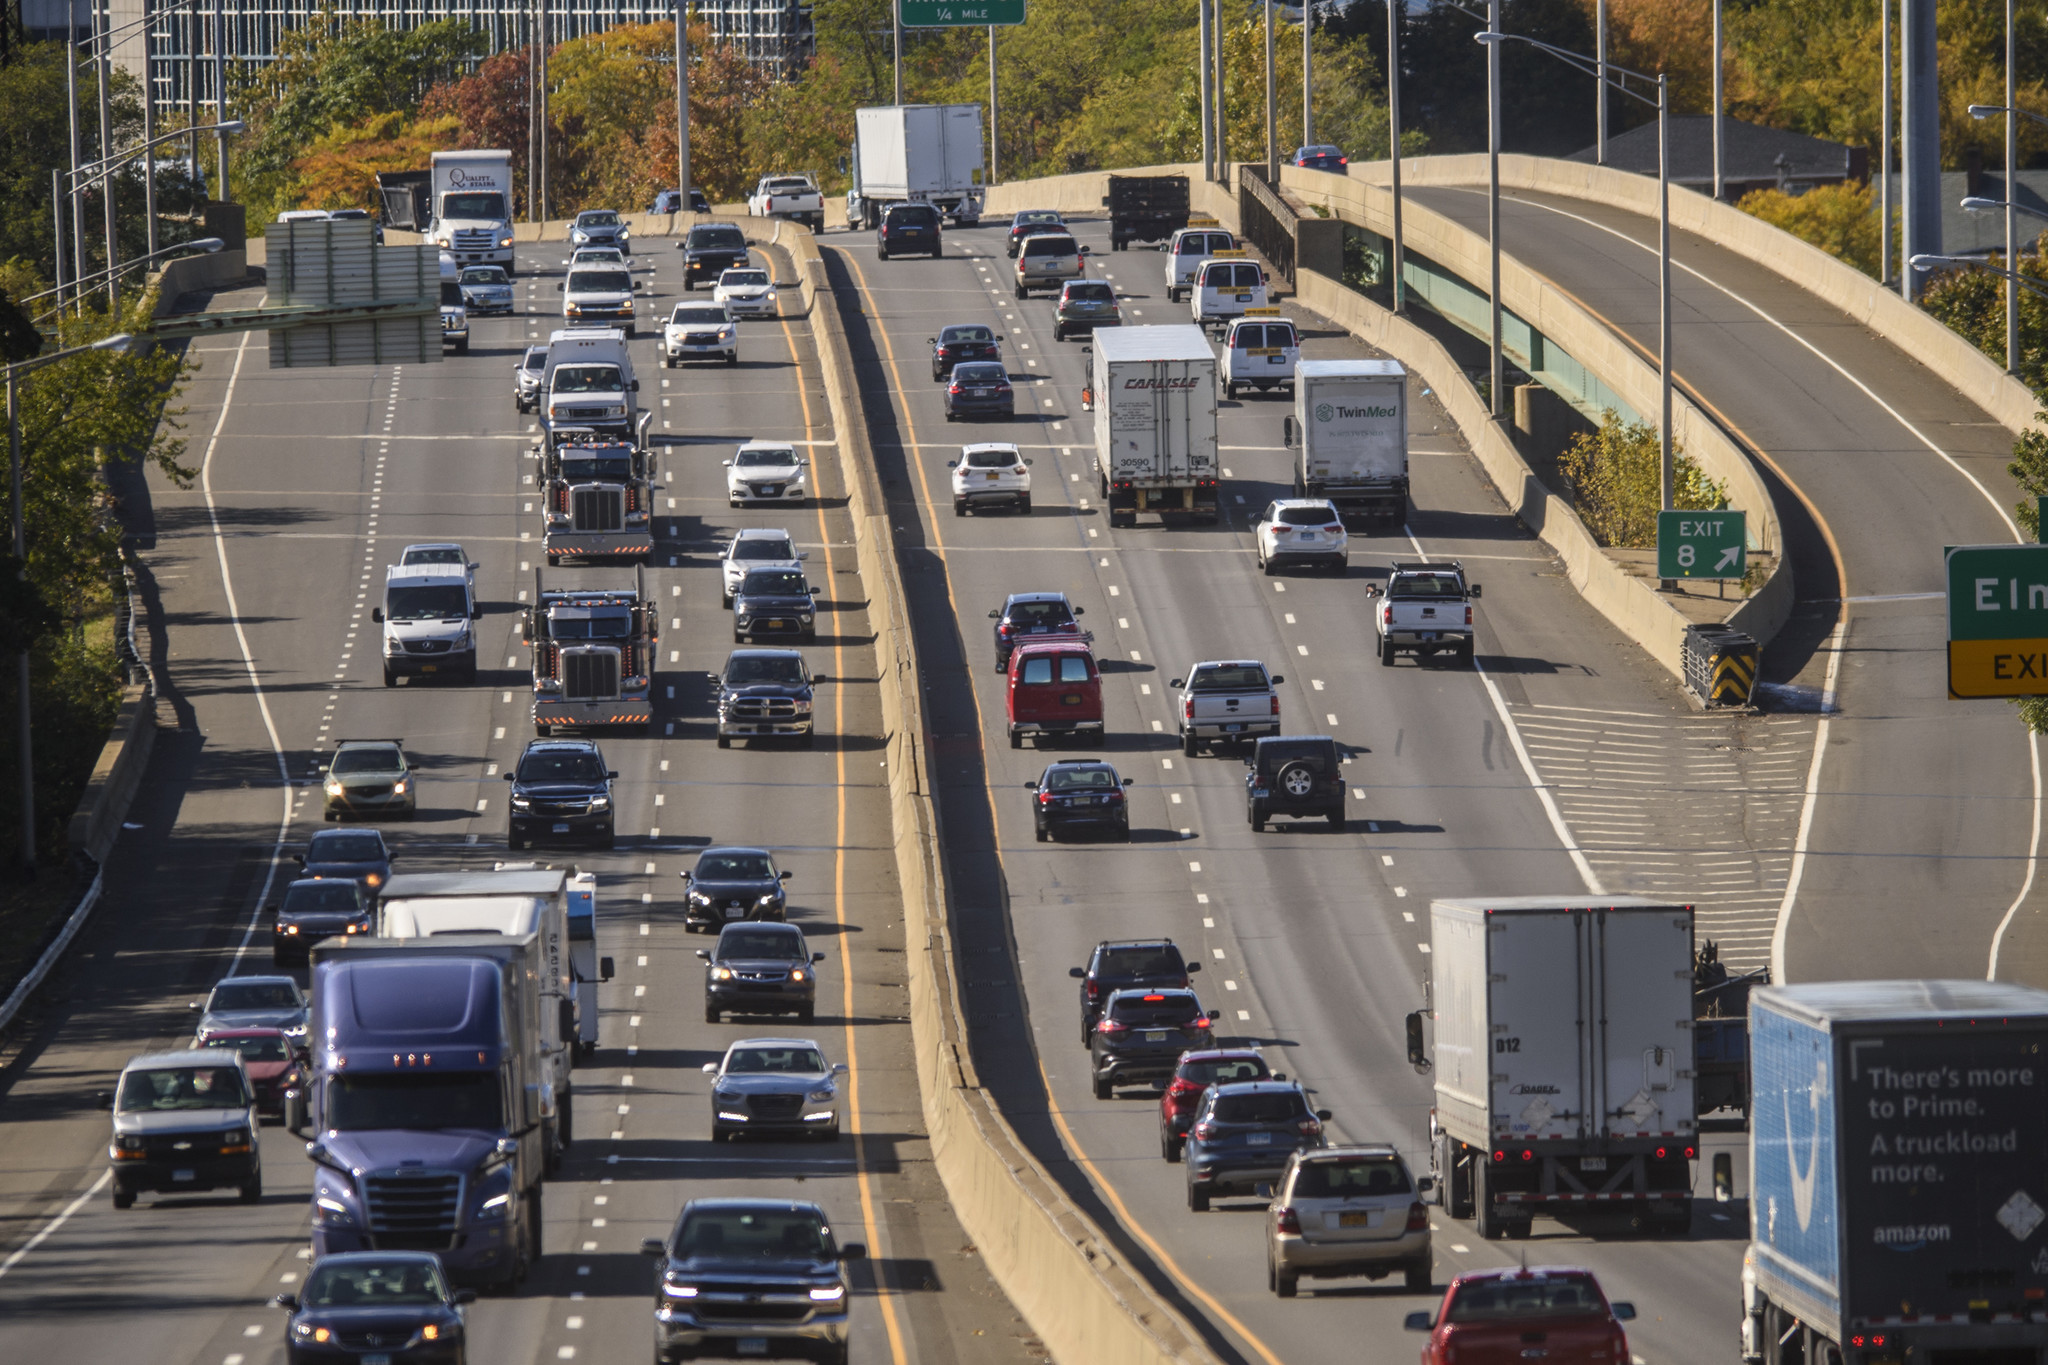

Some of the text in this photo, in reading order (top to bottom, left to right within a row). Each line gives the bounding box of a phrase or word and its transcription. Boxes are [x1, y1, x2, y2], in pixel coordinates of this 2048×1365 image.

[962, 9, 988, 19] MILE
[449, 168, 490, 188] QUALITY
[1124, 377, 1200, 389] CARLISLE
[1336, 405, 1397, 418] TwinMed
[1120, 458, 1149, 466] 30590
[1680, 521, 1724, 536] EXIT
[1677, 544, 1696, 567] 8
[1496, 1037, 1520, 1053] D12
[1867, 1066, 2034, 1090] There's more
[1868, 1094, 1985, 1119] to Prime.
[1870, 1129, 2016, 1156] A truckload
[1871, 1163, 1945, 1183] more.
[1873, 1224, 1951, 1244] amazon
